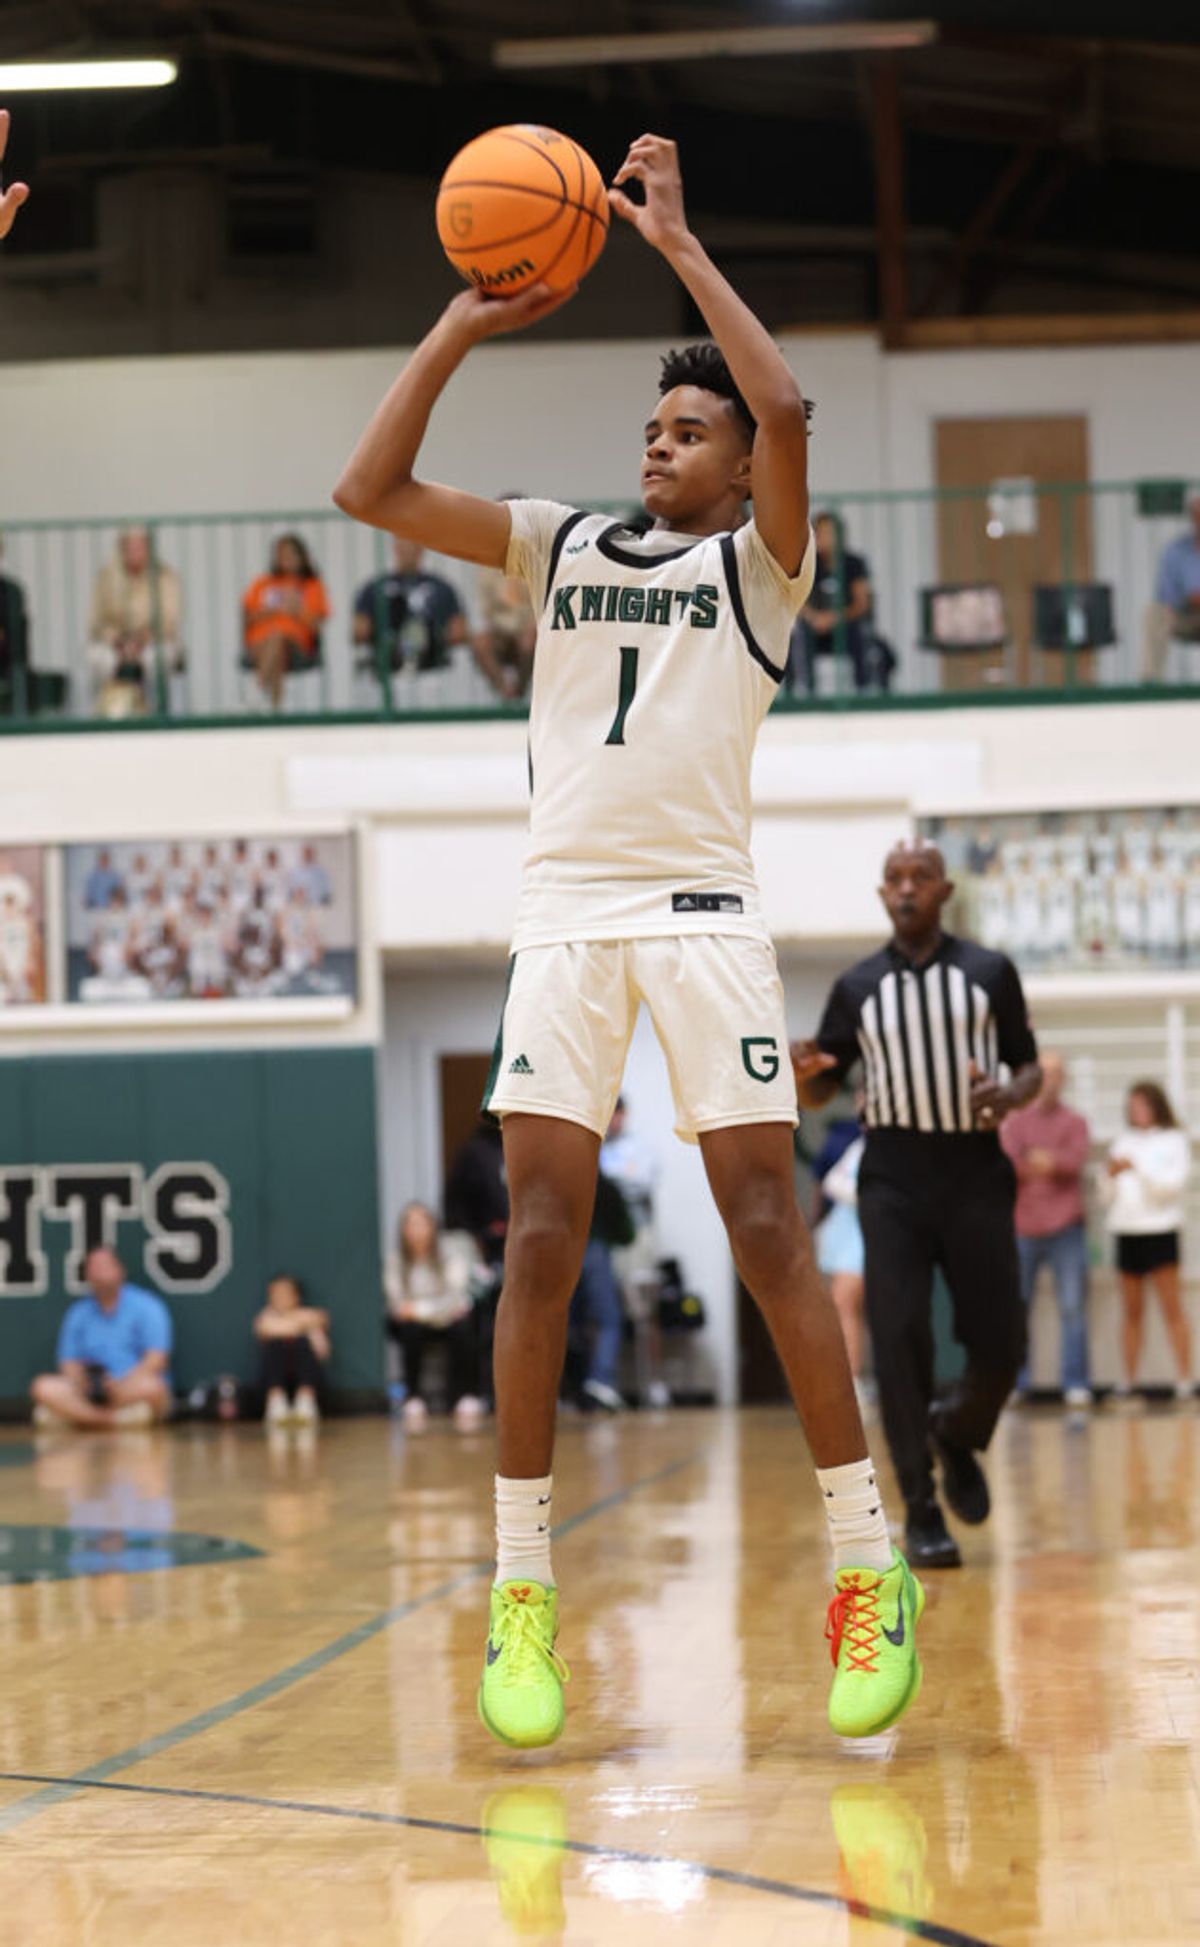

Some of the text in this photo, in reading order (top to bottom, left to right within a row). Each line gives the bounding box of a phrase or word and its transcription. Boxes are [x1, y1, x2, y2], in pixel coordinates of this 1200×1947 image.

[551, 584, 719, 630] KNIGHTS
[604, 646, 639, 746] 1
[740, 1037, 779, 1084] G
